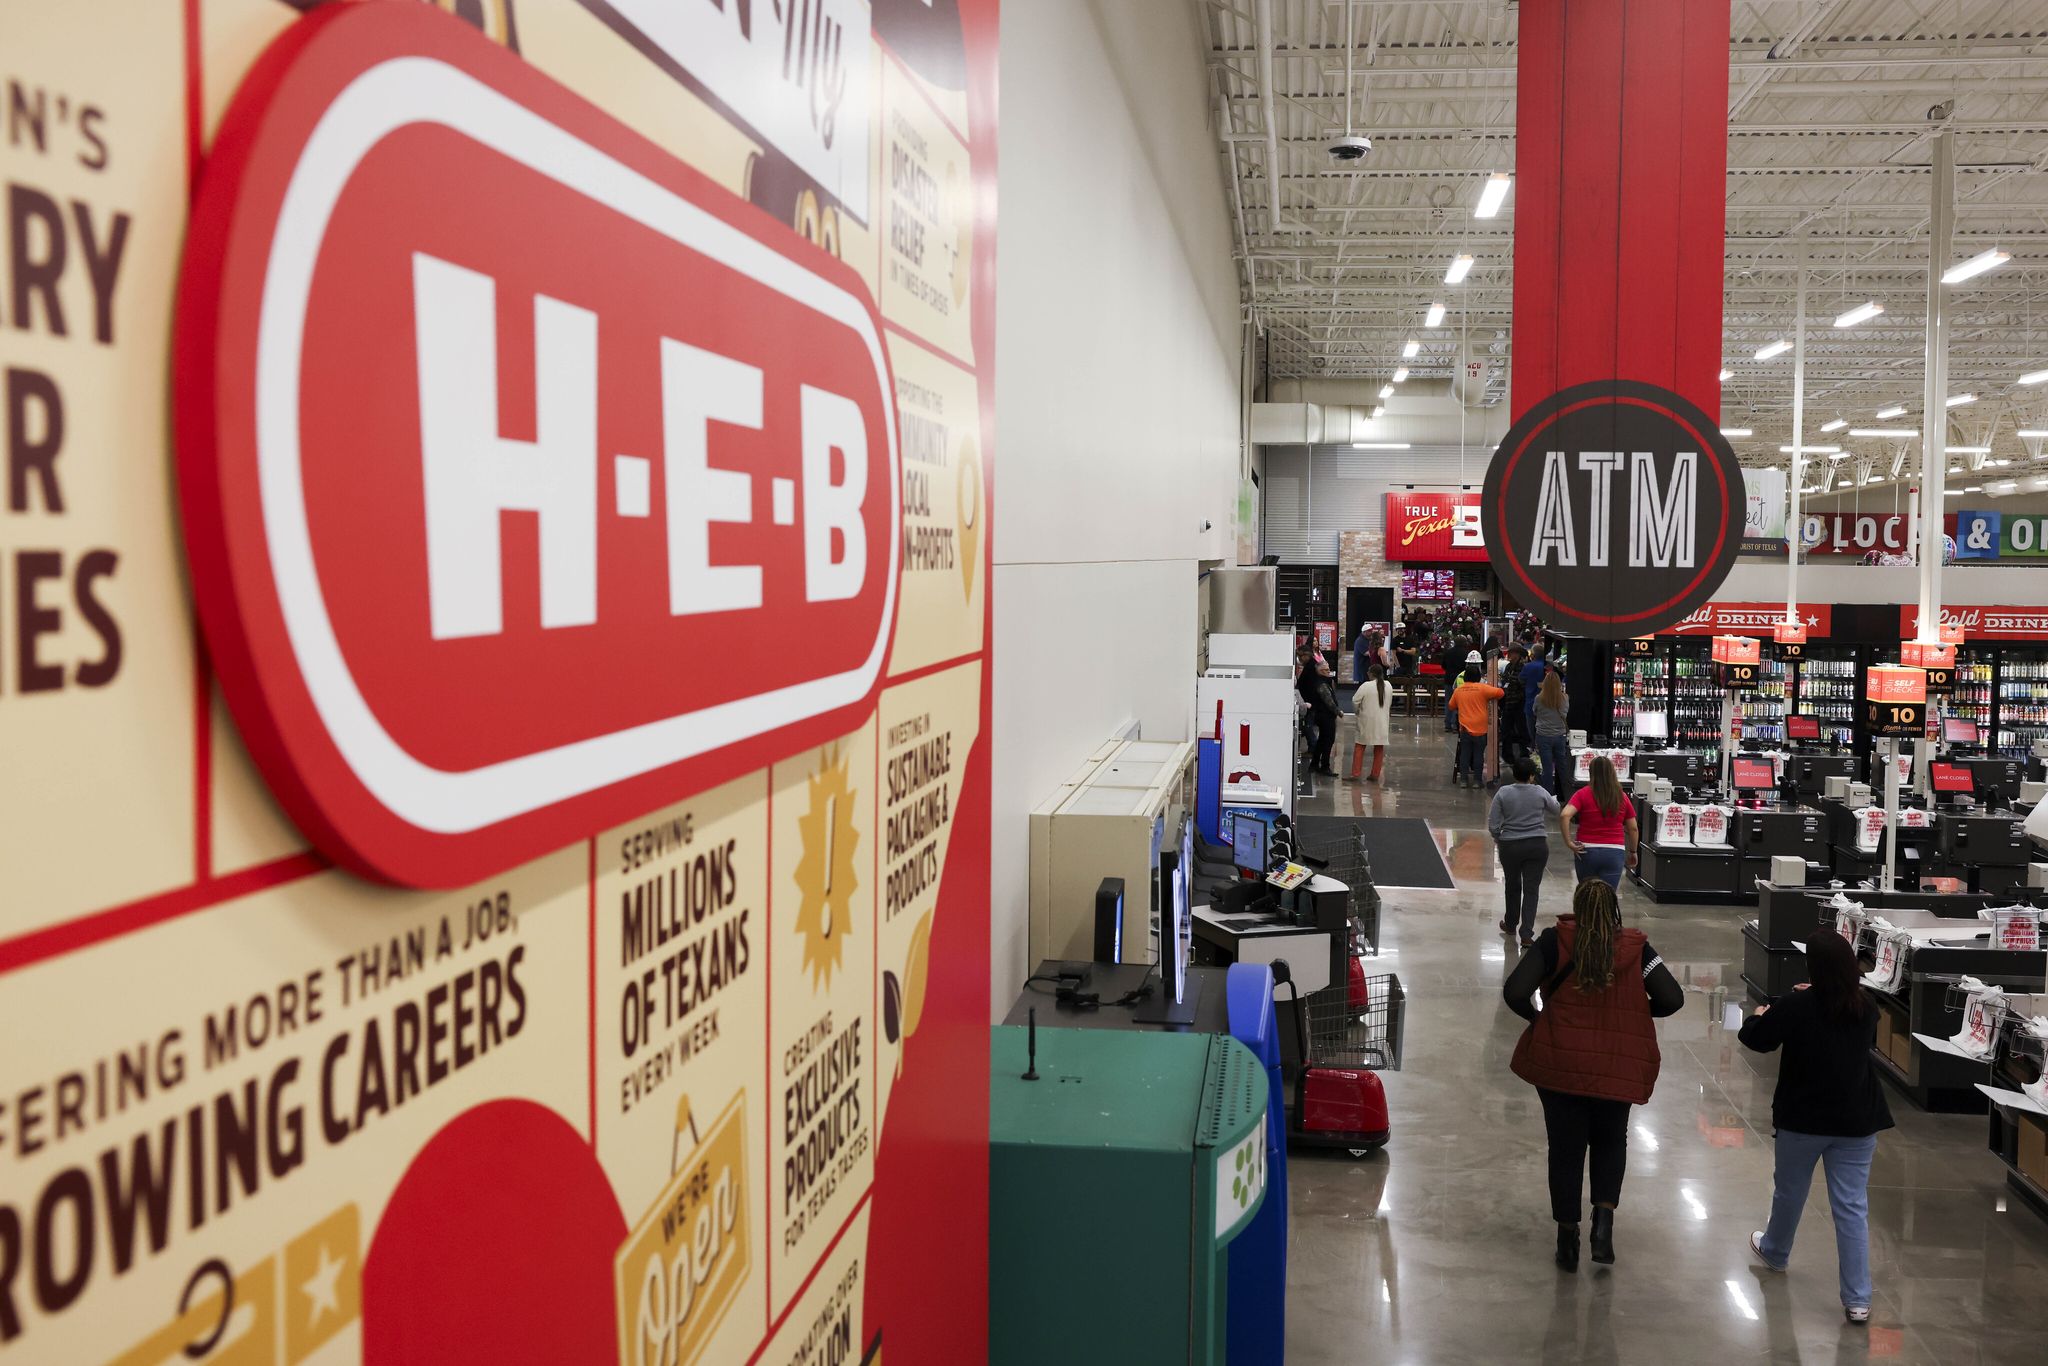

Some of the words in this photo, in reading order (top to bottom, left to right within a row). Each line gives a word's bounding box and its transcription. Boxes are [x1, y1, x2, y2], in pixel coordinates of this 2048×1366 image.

[9, 78, 109, 172] N'S
[892, 140, 938, 227] DISASTER
[891, 200, 925, 268] RELIEF
[891, 257, 898, 283] IN
[900, 264, 919, 297] TIMES
[921, 279, 928, 302] OF
[930, 283, 949, 316] CRISIS
[902, 467, 930, 517] OCAL
[1405, 506, 1438, 516] TRUE
[1529, 451, 1697, 568] ATM
[1401, 515, 1458, 546] Texas
[1755, 543, 1761, 551] OF
[1762, 543, 1777, 551] TEXAS
[1967, 518, 1991, 549] &
[0, 547, 124, 696] ES
[1634, 641, 1648, 651] 10
[1717, 614, 1799, 625] DRINK
[1786, 645, 1801, 655] 10
[1733, 667, 1752, 679] 10
[1884, 686, 1913, 694] CHECK
[1894, 679, 1916, 687] SELF
[1928, 671, 1947, 684] 10
[887, 716, 922, 750] INVESTING
[924, 712, 930, 734] IN
[1868, 704, 1877, 721] 10
[1890, 707, 1915, 723] 10
[887, 730, 951, 808] SUSTAINABLE
[621, 812, 693, 875] SERVING
[887, 786, 940, 865] PACKAGING
[942, 781, 948, 824] &
[1226, 810, 1257, 819] Coler
[622, 838, 736, 968] MILLIONS
[886, 838, 937, 923] PRODUCTS
[2016, 937, 2036, 945] PRICES
[204, 968, 323, 1072] MORE
[336, 925, 426, 1009] THAN
[436, 914, 452, 962] A
[462, 890, 518, 951] JOB,
[621, 968, 656, 1058] OF
[662, 908, 749, 1030] TEXANS
[320, 943, 527, 1147] CAREERS
[622, 1041, 675, 1114] EVERY
[679, 1008, 720, 1067] WEEK
[784, 1010, 832, 1076] CREATING
[785, 1016, 861, 1147] EXCLUSIVE
[785, 1077, 861, 1217] PRODUCTS
[661, 1160, 709, 1246] WE'RE
[784, 1208, 805, 1257] FOR
[808, 1168, 837, 1226] TEXAS
[838, 1126, 868, 1183] TASTES
[635, 1164, 740, 1366] Open
[787, 1296, 835, 1366] ONATING
[835, 1258, 858, 1309] OVER
